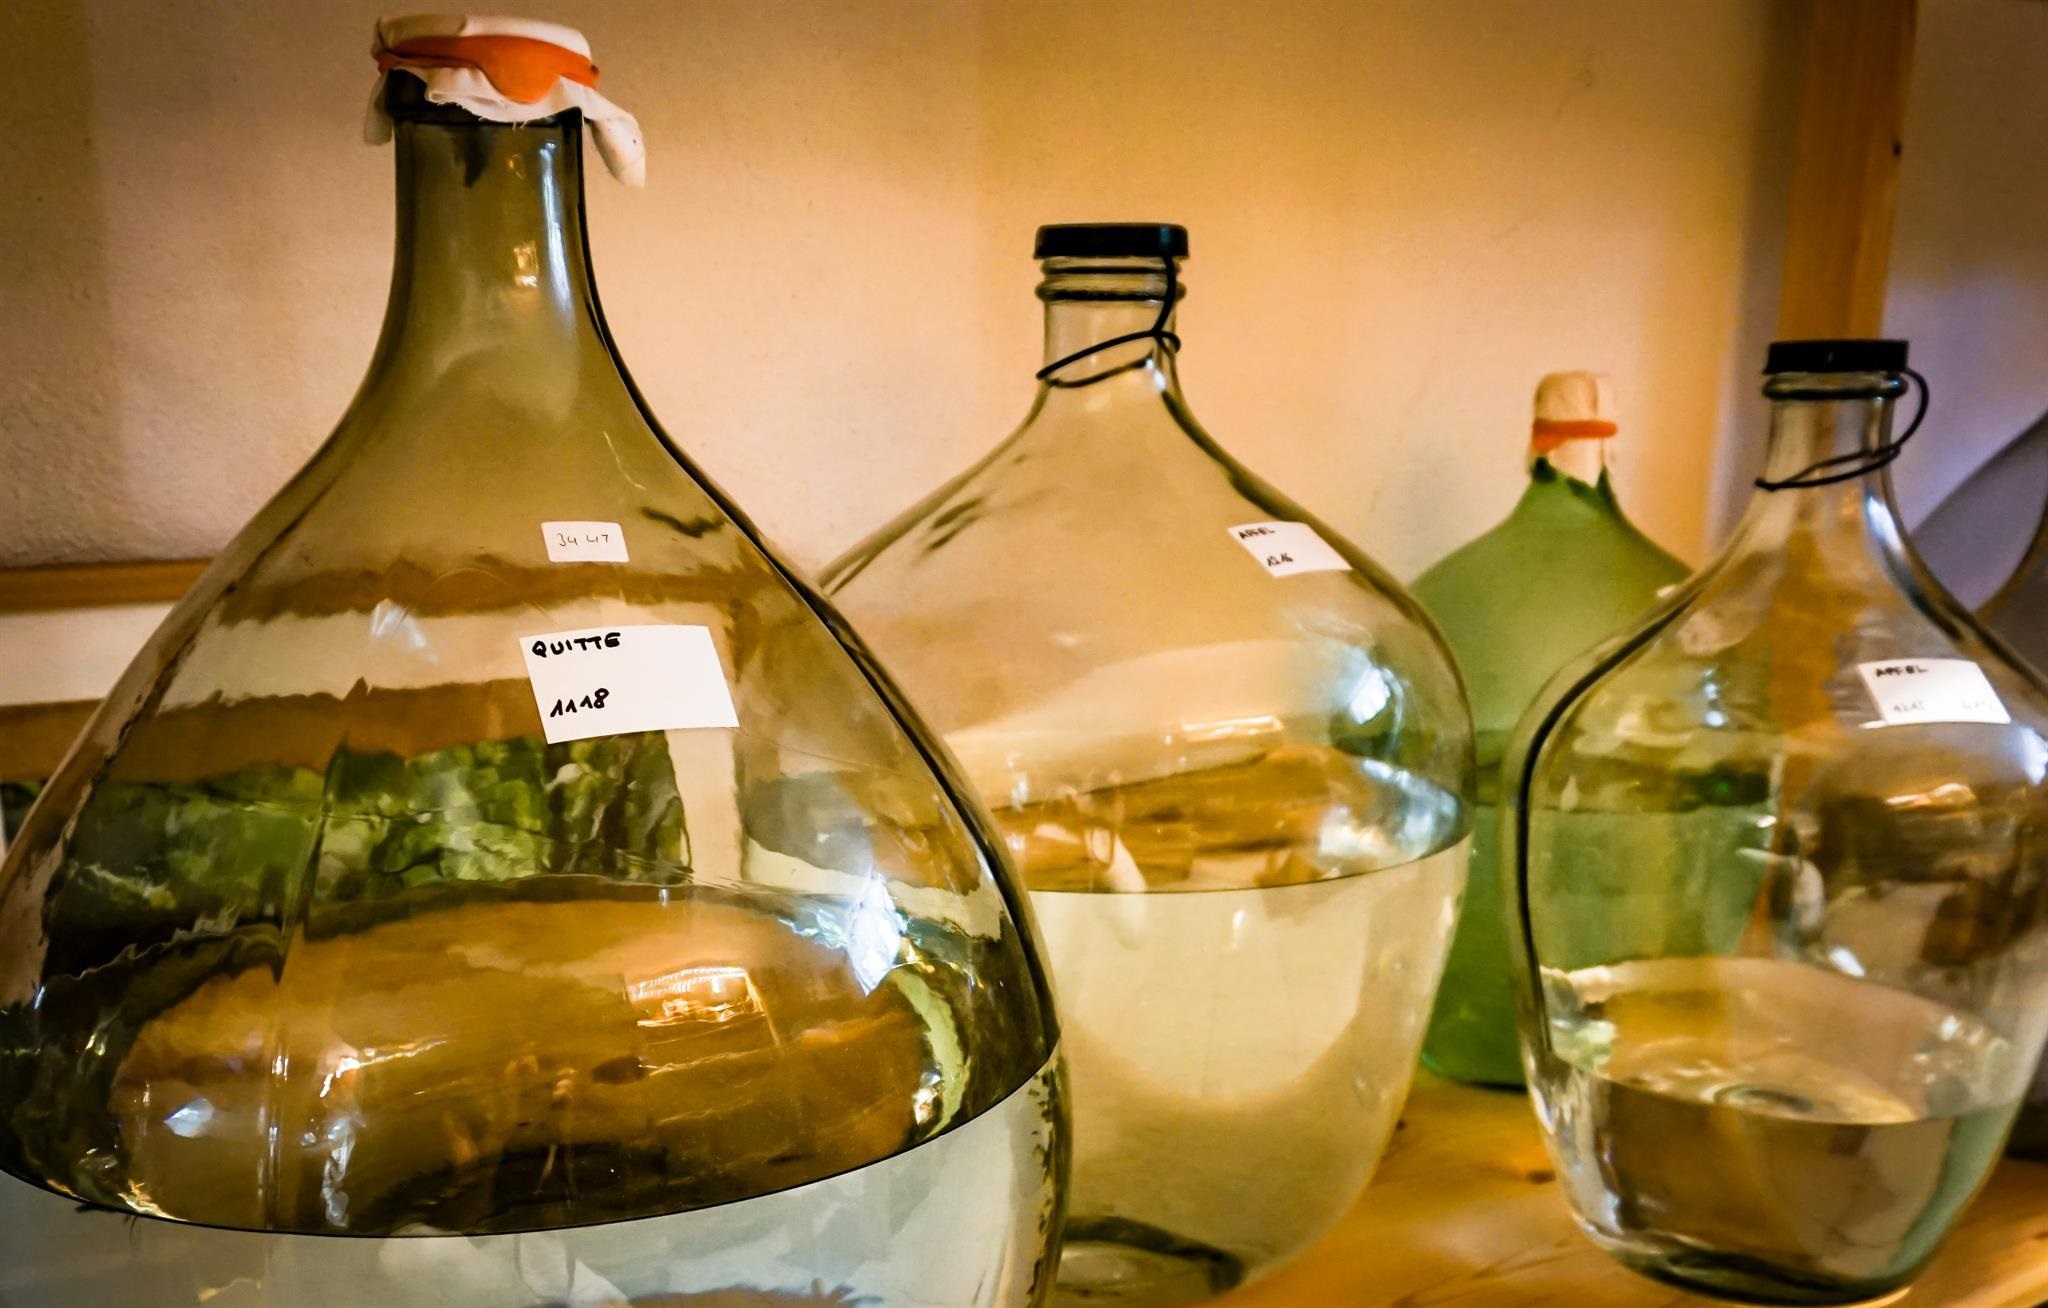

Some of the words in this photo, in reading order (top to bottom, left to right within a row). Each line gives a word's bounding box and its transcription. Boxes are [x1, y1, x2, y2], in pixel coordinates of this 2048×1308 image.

[556, 532, 578, 547] 34
[531, 632, 621, 658] QUITTE
[549, 687, 610, 718] 1118
